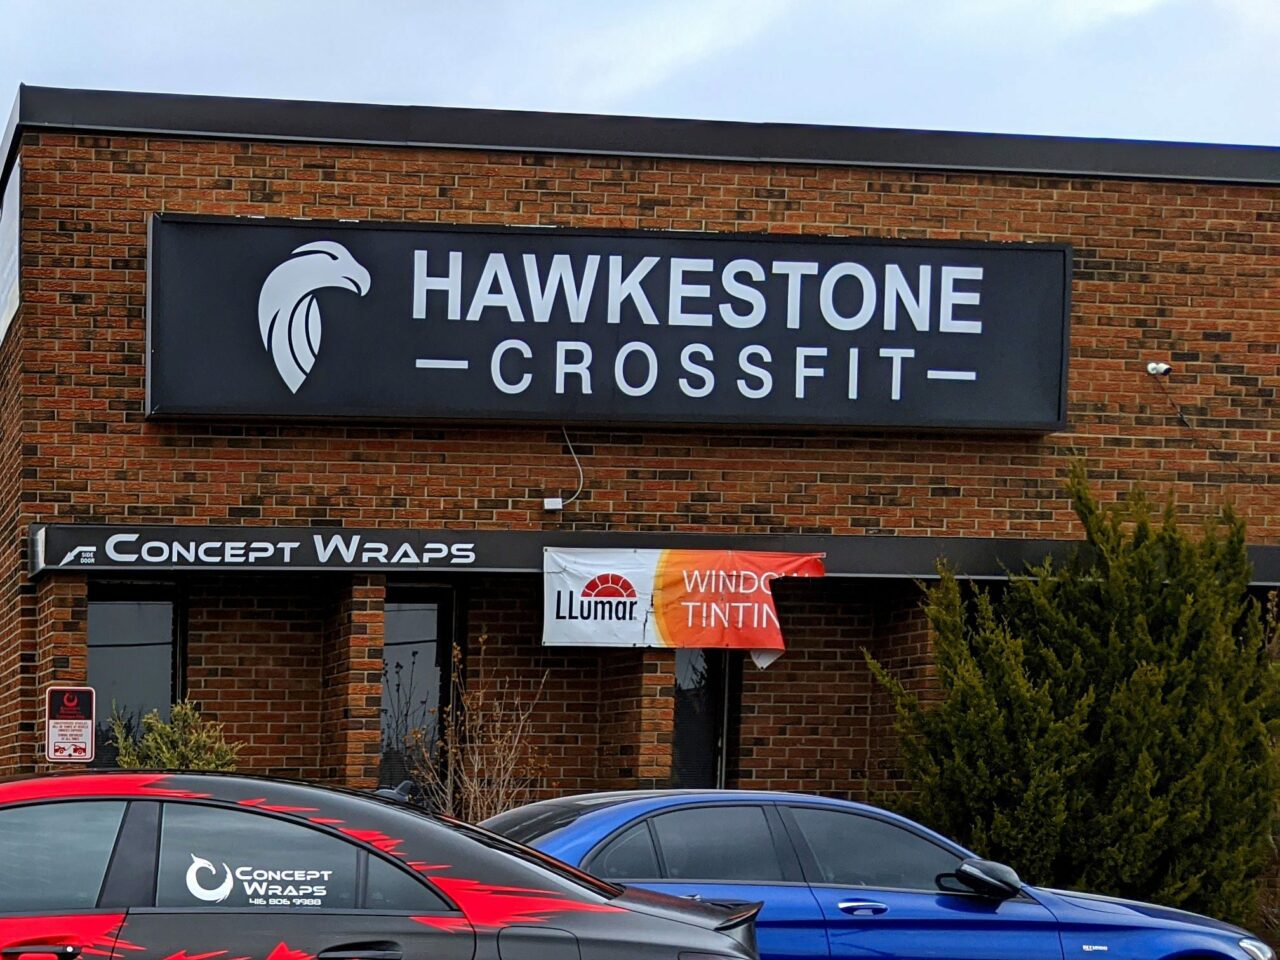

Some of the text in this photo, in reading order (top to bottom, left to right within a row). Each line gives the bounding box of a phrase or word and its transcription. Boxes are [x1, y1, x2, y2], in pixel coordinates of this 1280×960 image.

[412, 249, 984, 334] HAWKESTONE
[490, 338, 916, 401] CROSSFIT
[104, 533, 477, 564] CONCEPT WRAPS
[682, 569, 809, 595] WINDO
[554, 590, 638, 621] LLumar
[235, 866, 333, 881] CONCEPT
[243, 881, 327, 896] WRAPS
[293, 898, 322, 906] 9988
